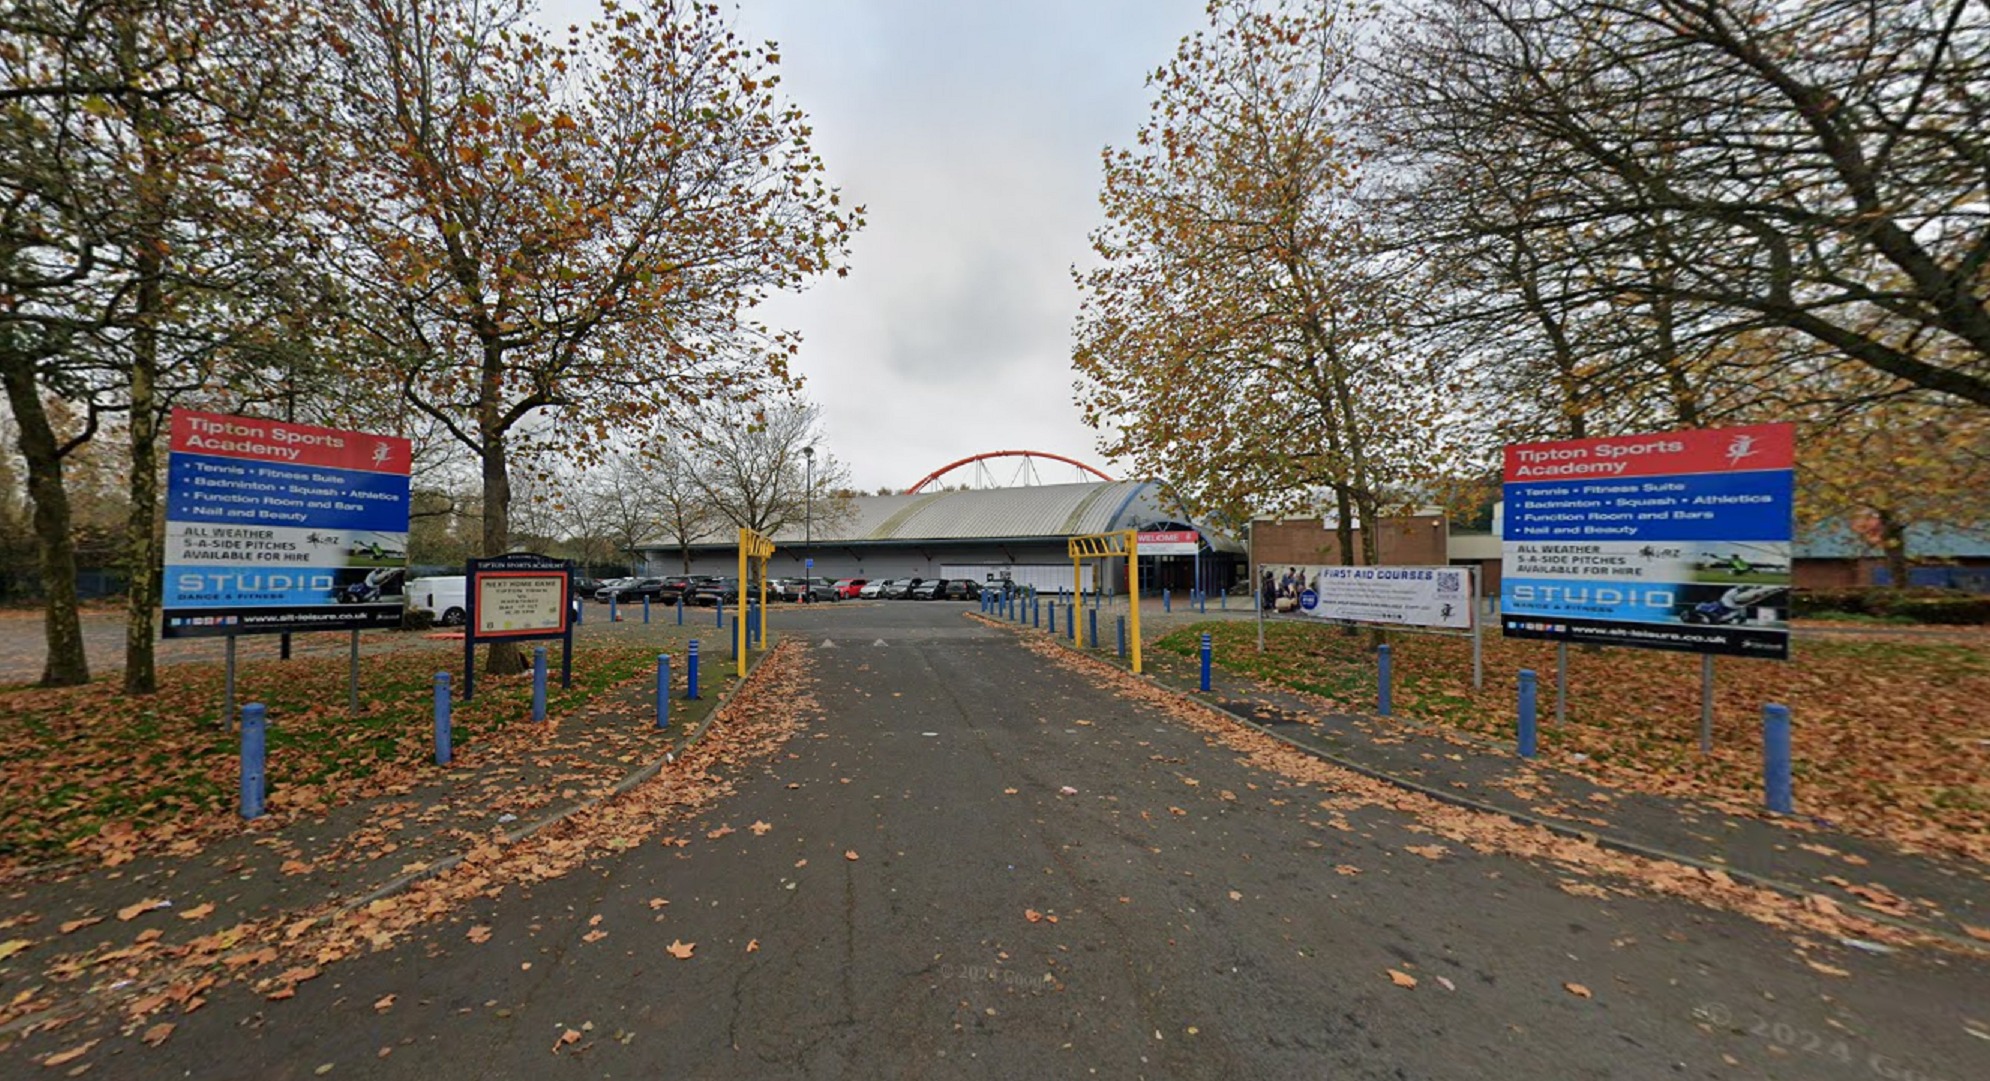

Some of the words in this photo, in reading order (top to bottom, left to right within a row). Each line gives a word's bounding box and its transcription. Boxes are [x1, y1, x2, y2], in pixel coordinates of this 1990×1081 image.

[187, 417, 264, 438] Tipton
[272, 428, 344, 449] Sports
[186, 434, 300, 460] Academy
[1516, 449, 1588, 463] Tipton
[1595, 441, 1684, 458] Sports
[195, 462, 245, 475] Tennis
[258, 468, 309, 481] Fitness
[312, 474, 345, 484] Suite
[1516, 461, 1627, 477] Academy
[194, 477, 276, 492] Badminton
[289, 485, 338, 497] Squash
[349, 490, 400, 502] Athletics
[1525, 487, 1569, 497] Tennis
[1583, 484, 1638, 495] Fitness
[1643, 482, 1686, 492] Suite
[193, 491, 259, 504] Function
[263, 496, 304, 508] Room
[307, 500, 332, 510] and
[335, 502, 364, 512] Bars
[1524, 499, 1601, 510] Badminton
[1616, 497, 1676, 508] Squash
[1693, 494, 1773, 505] Athletics
[192, 506, 223, 516] Nail
[227, 507, 255, 518] and
[259, 510, 308, 522] Beauty
[1524, 512, 1584, 522] Function
[1588, 511, 1633, 521] Room
[1638, 510, 1669, 520] and
[1673, 510, 1714, 520] Bars
[184, 527, 208, 536] ALL
[213, 528, 274, 539] WEATHER
[1137, 534, 1180, 542] WELCOME
[1524, 525, 1550, 535] Nail
[1553, 525, 1580, 535] and
[1584, 525, 1638, 536] Beauty
[245, 541, 296, 551] PITCHES
[1517, 545, 1537, 554] ALL
[1541, 545, 1601, 554] WEATHER
[183, 550, 252, 561] AVAILABLE
[257, 552, 280, 561] FOR
[284, 553, 310, 562] HIRE
[1572, 556, 1626, 565] PITCHES
[1323, 569, 1352, 578] FIRST
[1354, 570, 1375, 579] AID
[1377, 570, 1433, 580] COURSES
[1516, 566, 1579, 575] AVAILABLE
[1583, 567, 1609, 575] FOR
[1612, 567, 1643, 576] HIRE
[178, 574, 335, 592] STUDIO
[1512, 585, 1675, 609] STUDIO
